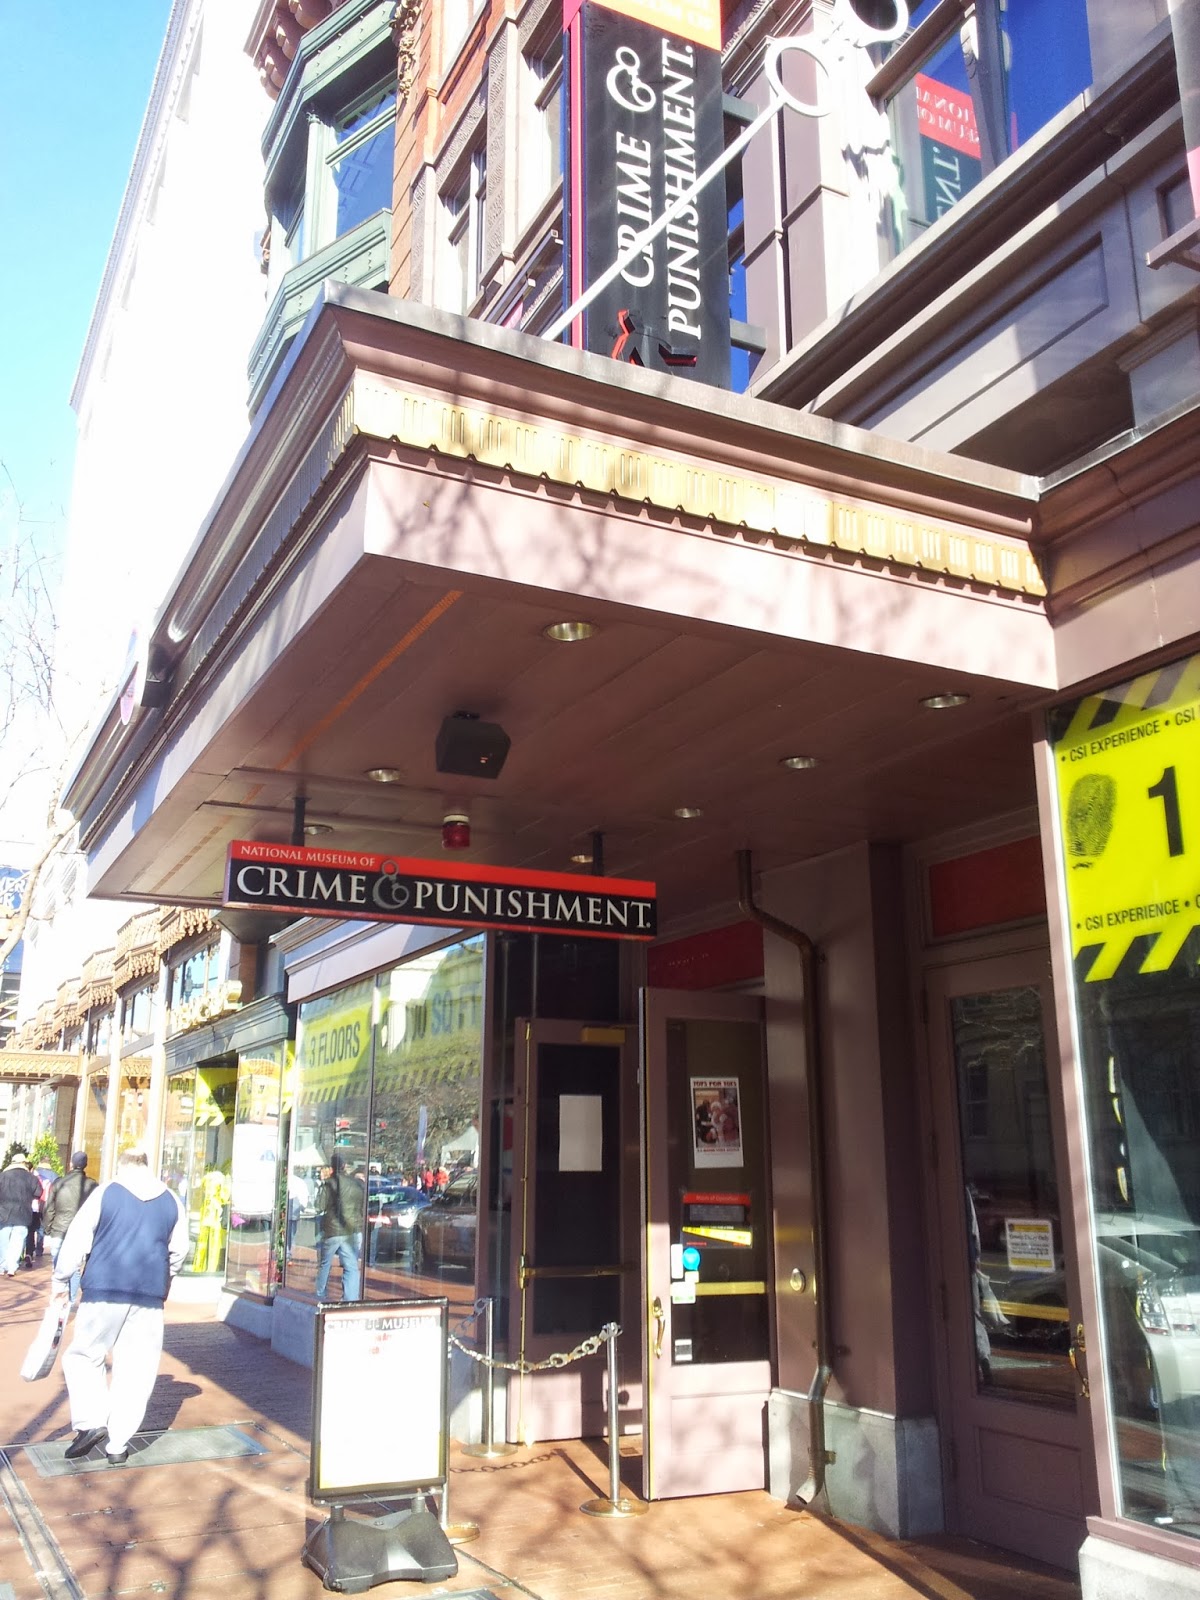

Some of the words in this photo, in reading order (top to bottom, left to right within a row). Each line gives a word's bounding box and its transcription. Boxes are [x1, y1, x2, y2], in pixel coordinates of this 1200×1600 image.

[615, 131, 655, 288] CRIME
[1069, 745, 1088, 762] CSI
[1090, 720, 1161, 755] EXPERIENCE
[1174, 707, 1196, 726] CSI
[1147, 765, 1186, 858] 1
[240, 845, 303, 861] NATIONAL
[306, 852, 357, 865] MUSEUM
[359, 857, 375, 867] OF
[236, 865, 367, 904] CRIME
[1085, 915, 1104, 931] CSI
[1107, 899, 1180, 926] EXPERIENCE
[318, 1021, 361, 1067] FLOORS
